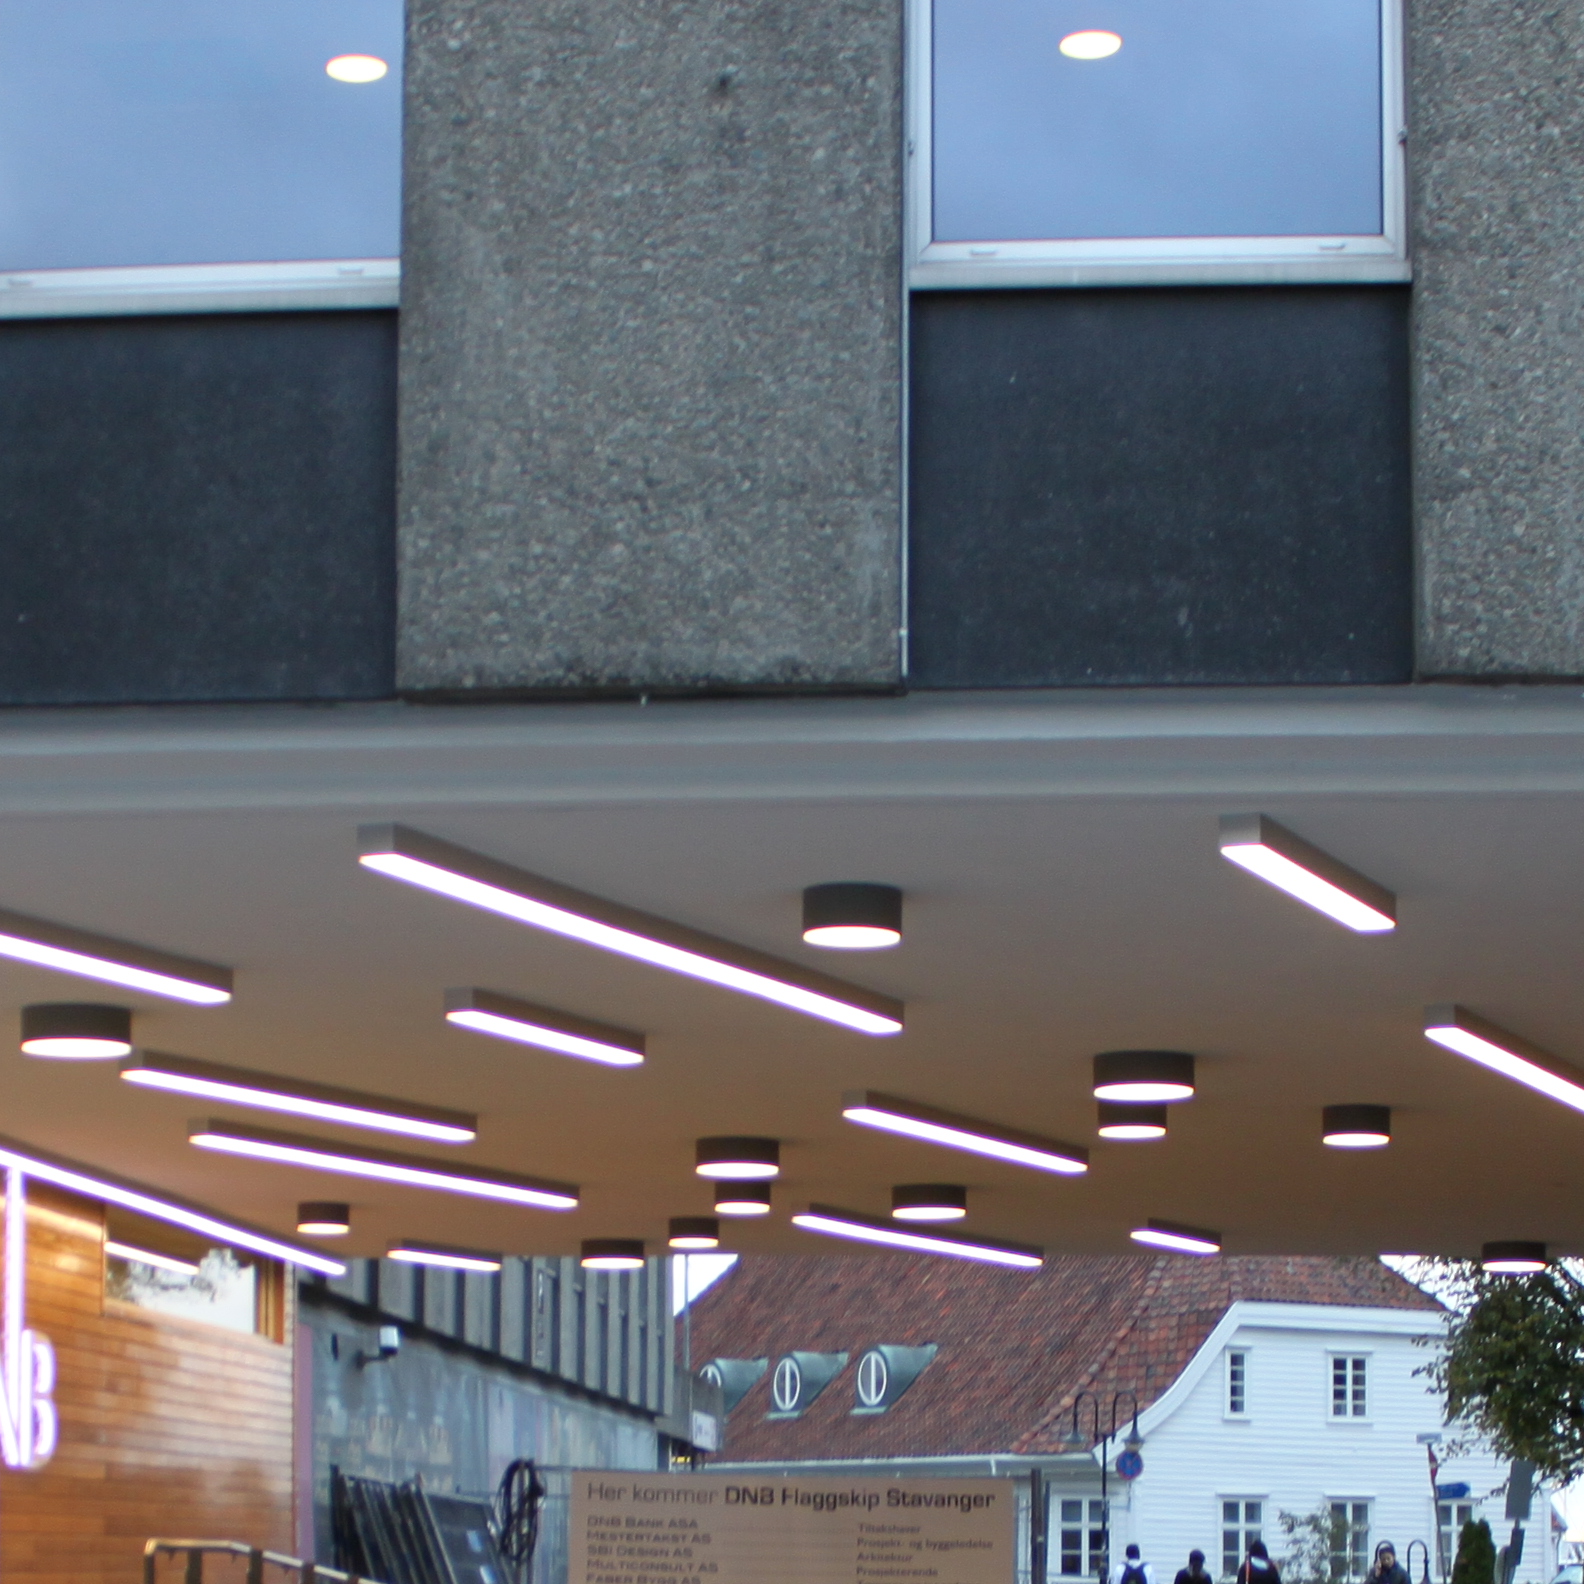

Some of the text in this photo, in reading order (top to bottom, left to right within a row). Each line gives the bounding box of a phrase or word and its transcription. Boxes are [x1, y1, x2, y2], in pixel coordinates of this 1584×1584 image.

[588, 1482, 996, 1512] Her kommer DNB Flaggskip Stavanger
[588, 1515, 621, 1527] DNB
[668, 1518, 698, 1529] ASA
[691, 1534, 712, 1544] AS
[909, 1541, 923, 1550] og
[673, 1548, 693, 1558] AS
[698, 1562, 718, 1573] AS
